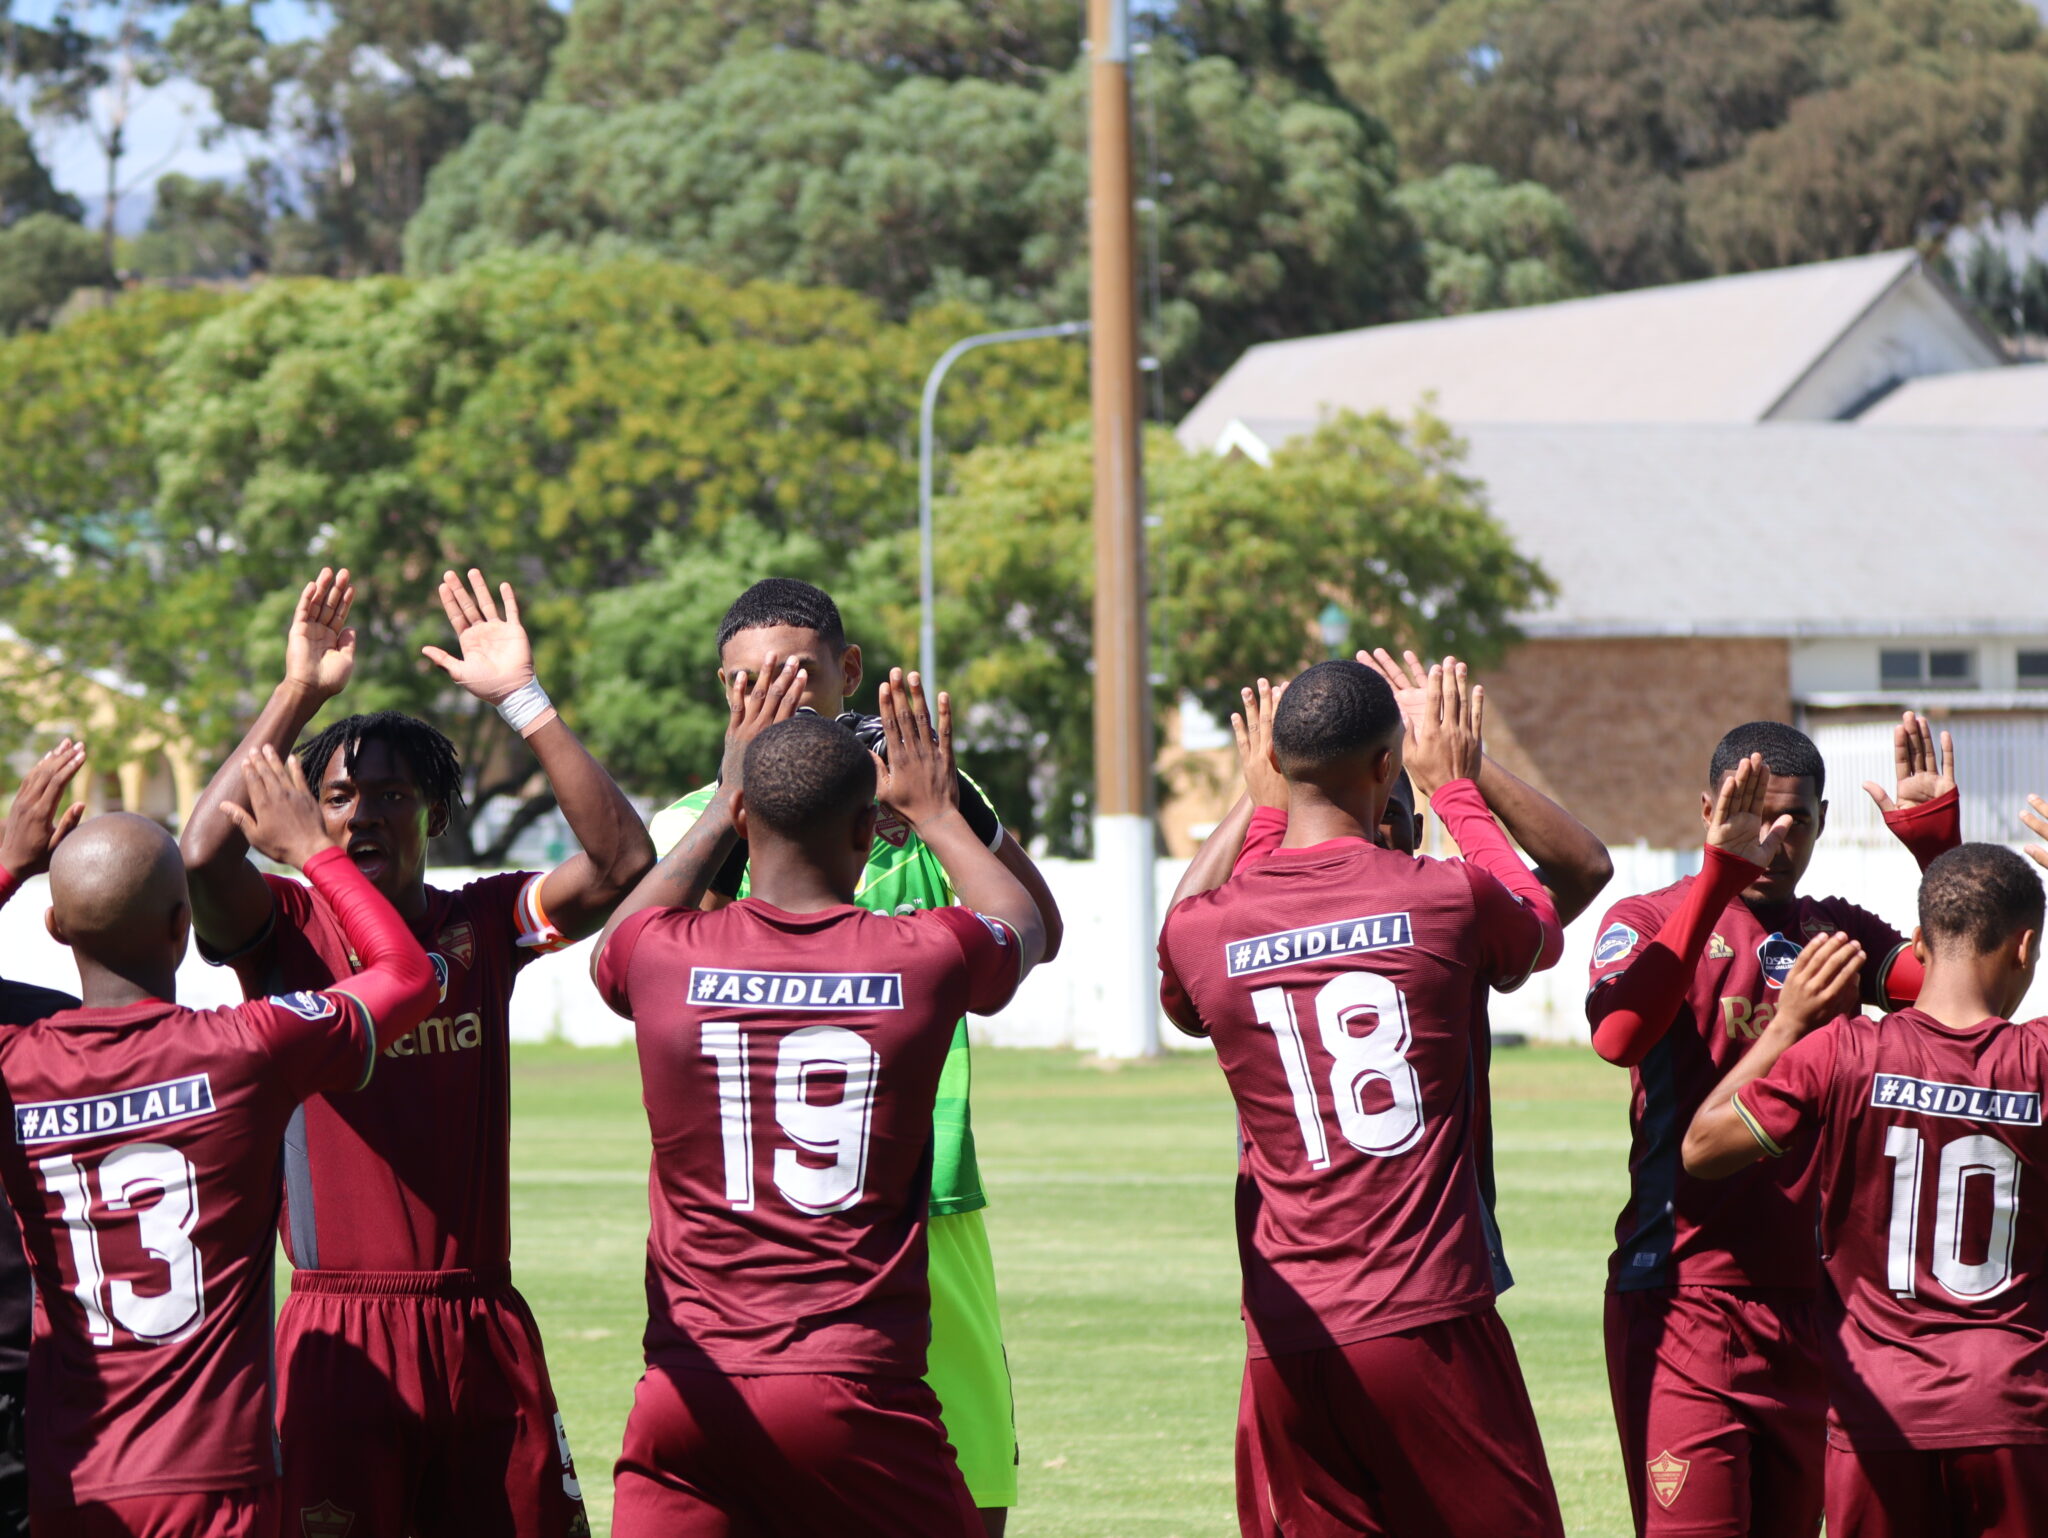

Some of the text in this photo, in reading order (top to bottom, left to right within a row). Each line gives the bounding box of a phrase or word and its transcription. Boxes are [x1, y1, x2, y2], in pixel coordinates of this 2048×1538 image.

[1234, 918, 1402, 970] #ASIDLALI
[697, 974, 892, 1004] #ASIDLALI
[384, 1012, 481, 1058] ama
[1720, 996, 1780, 1039] Ra
[1250, 971, 1426, 1171] 18
[22, 1081, 200, 1138] #ASIDLALI
[701, 1022, 880, 1215] 19
[1880, 1079, 2034, 1120] #ASIDLALI
[1884, 1125, 2023, 1301] 10
[39, 1142, 205, 1346] 13
